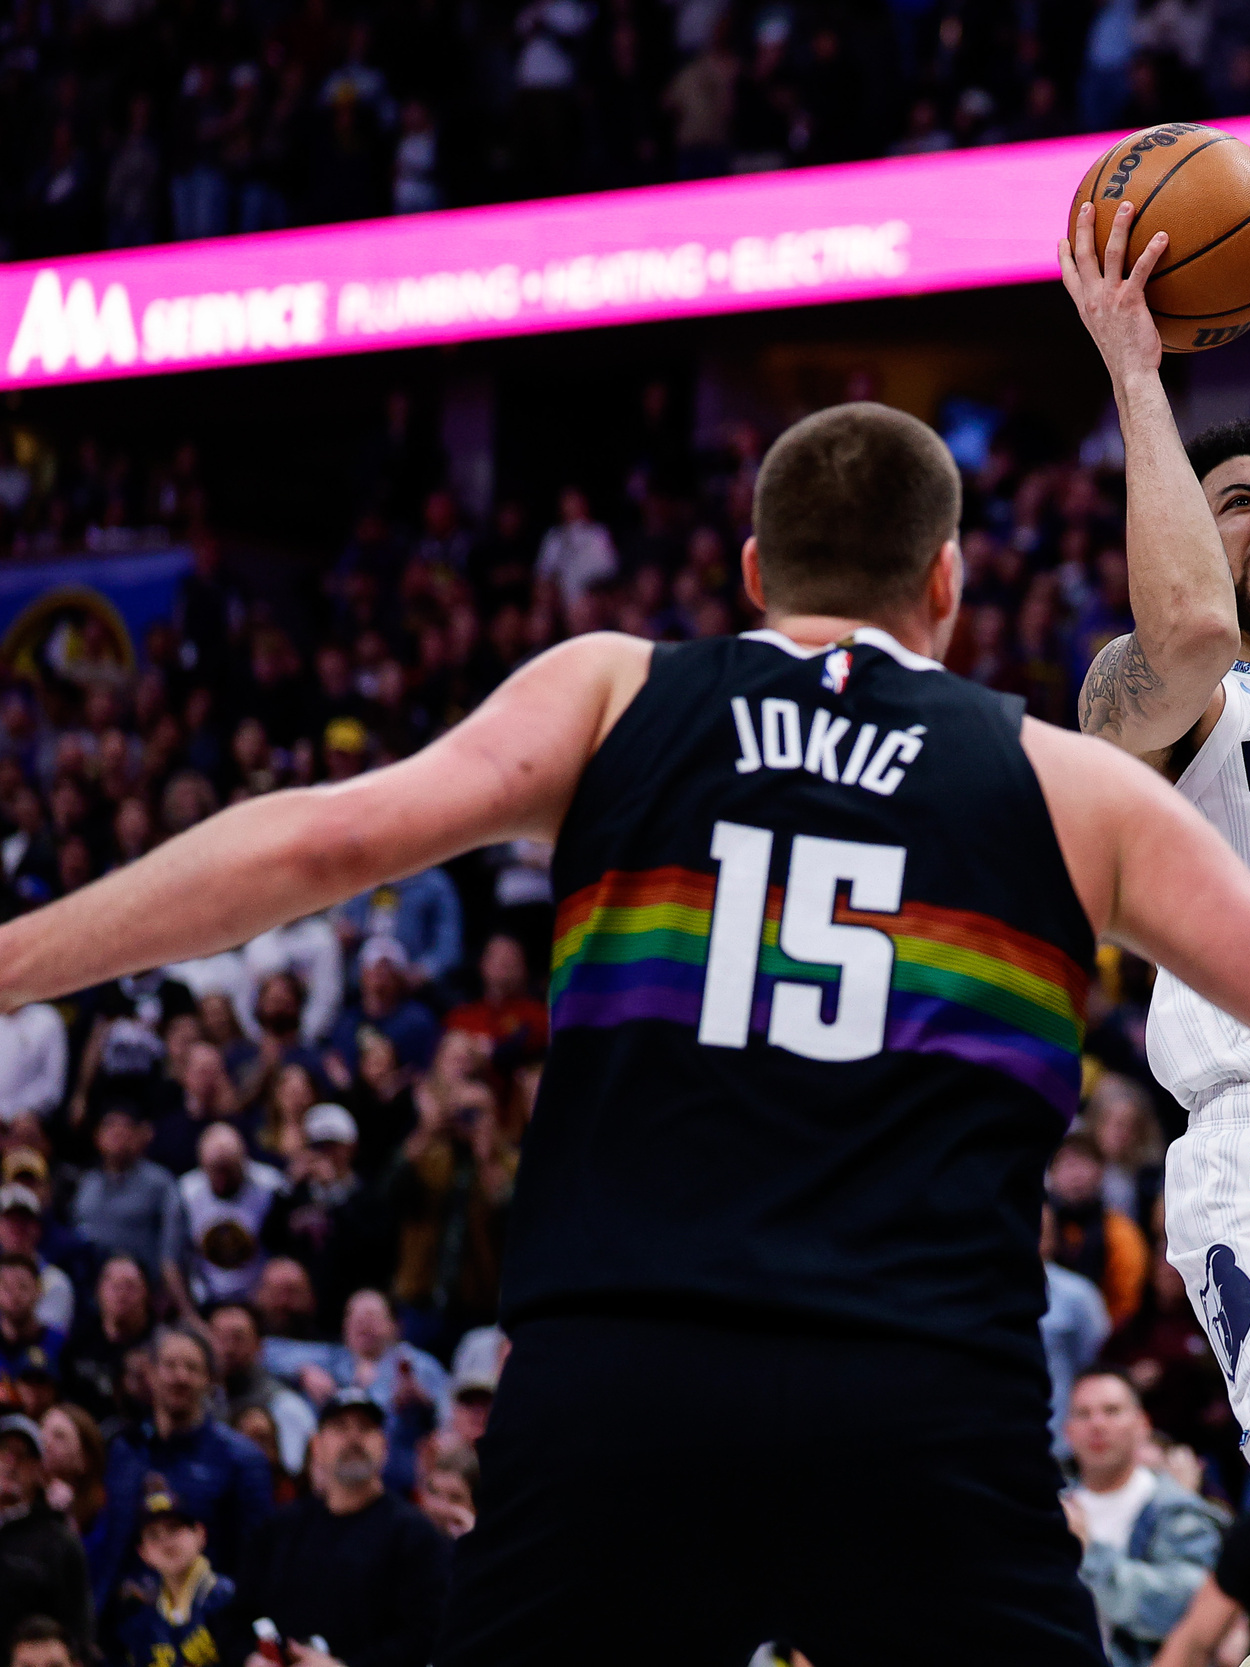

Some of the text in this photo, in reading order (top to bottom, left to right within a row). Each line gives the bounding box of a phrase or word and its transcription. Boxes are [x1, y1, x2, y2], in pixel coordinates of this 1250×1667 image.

[142, 280, 328, 364] SERVICE
[337, 264, 519, 335] PLUMBING
[543, 242, 706, 314] HEATING
[730, 219, 911, 293] ELECTRIC
[730, 696, 928, 796] JOKIĆ
[697, 820, 907, 1062] 15
